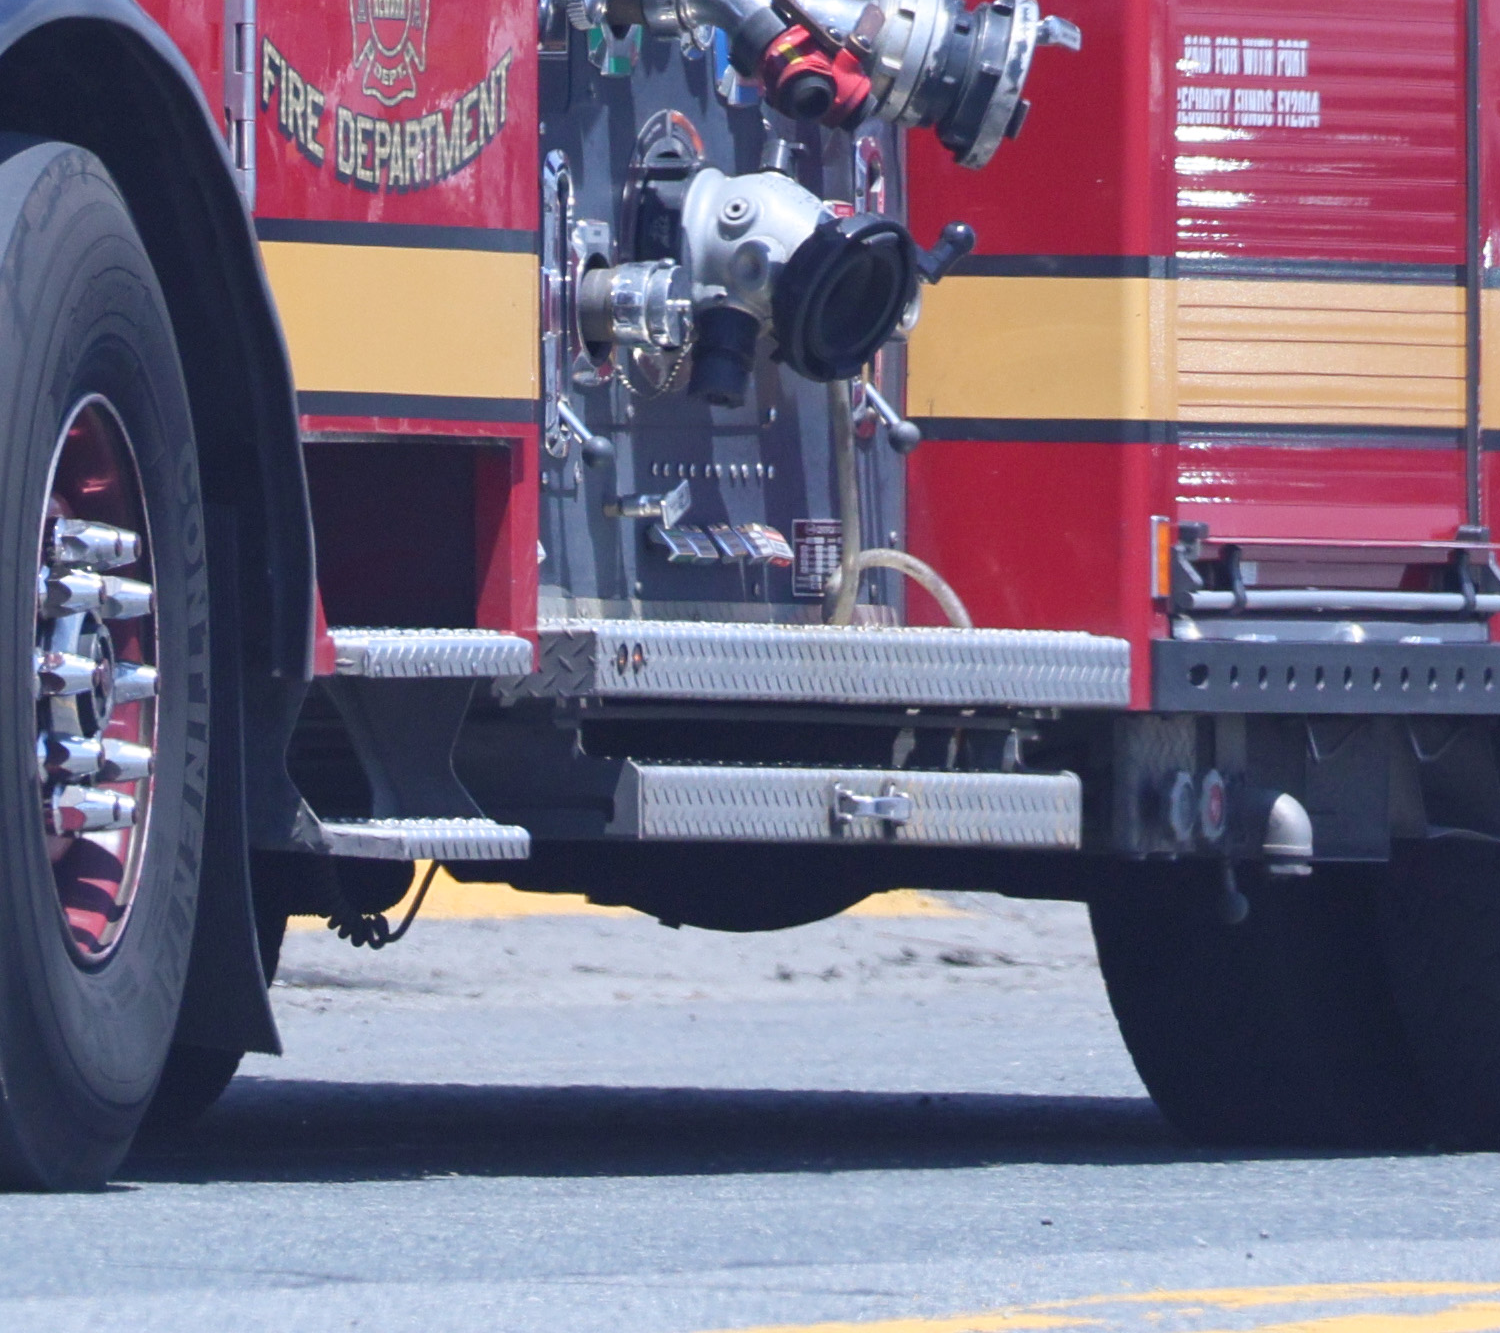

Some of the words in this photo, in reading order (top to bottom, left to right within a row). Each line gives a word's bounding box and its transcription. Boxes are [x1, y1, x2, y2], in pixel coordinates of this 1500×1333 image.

[1214, 36, 1240, 75] FOR
[1242, 37, 1275, 76] WITH
[261, 37, 327, 168] FIRE
[335, 48, 513, 193] DEPARTMENT
[1233, 88, 1274, 127] FUNDS
